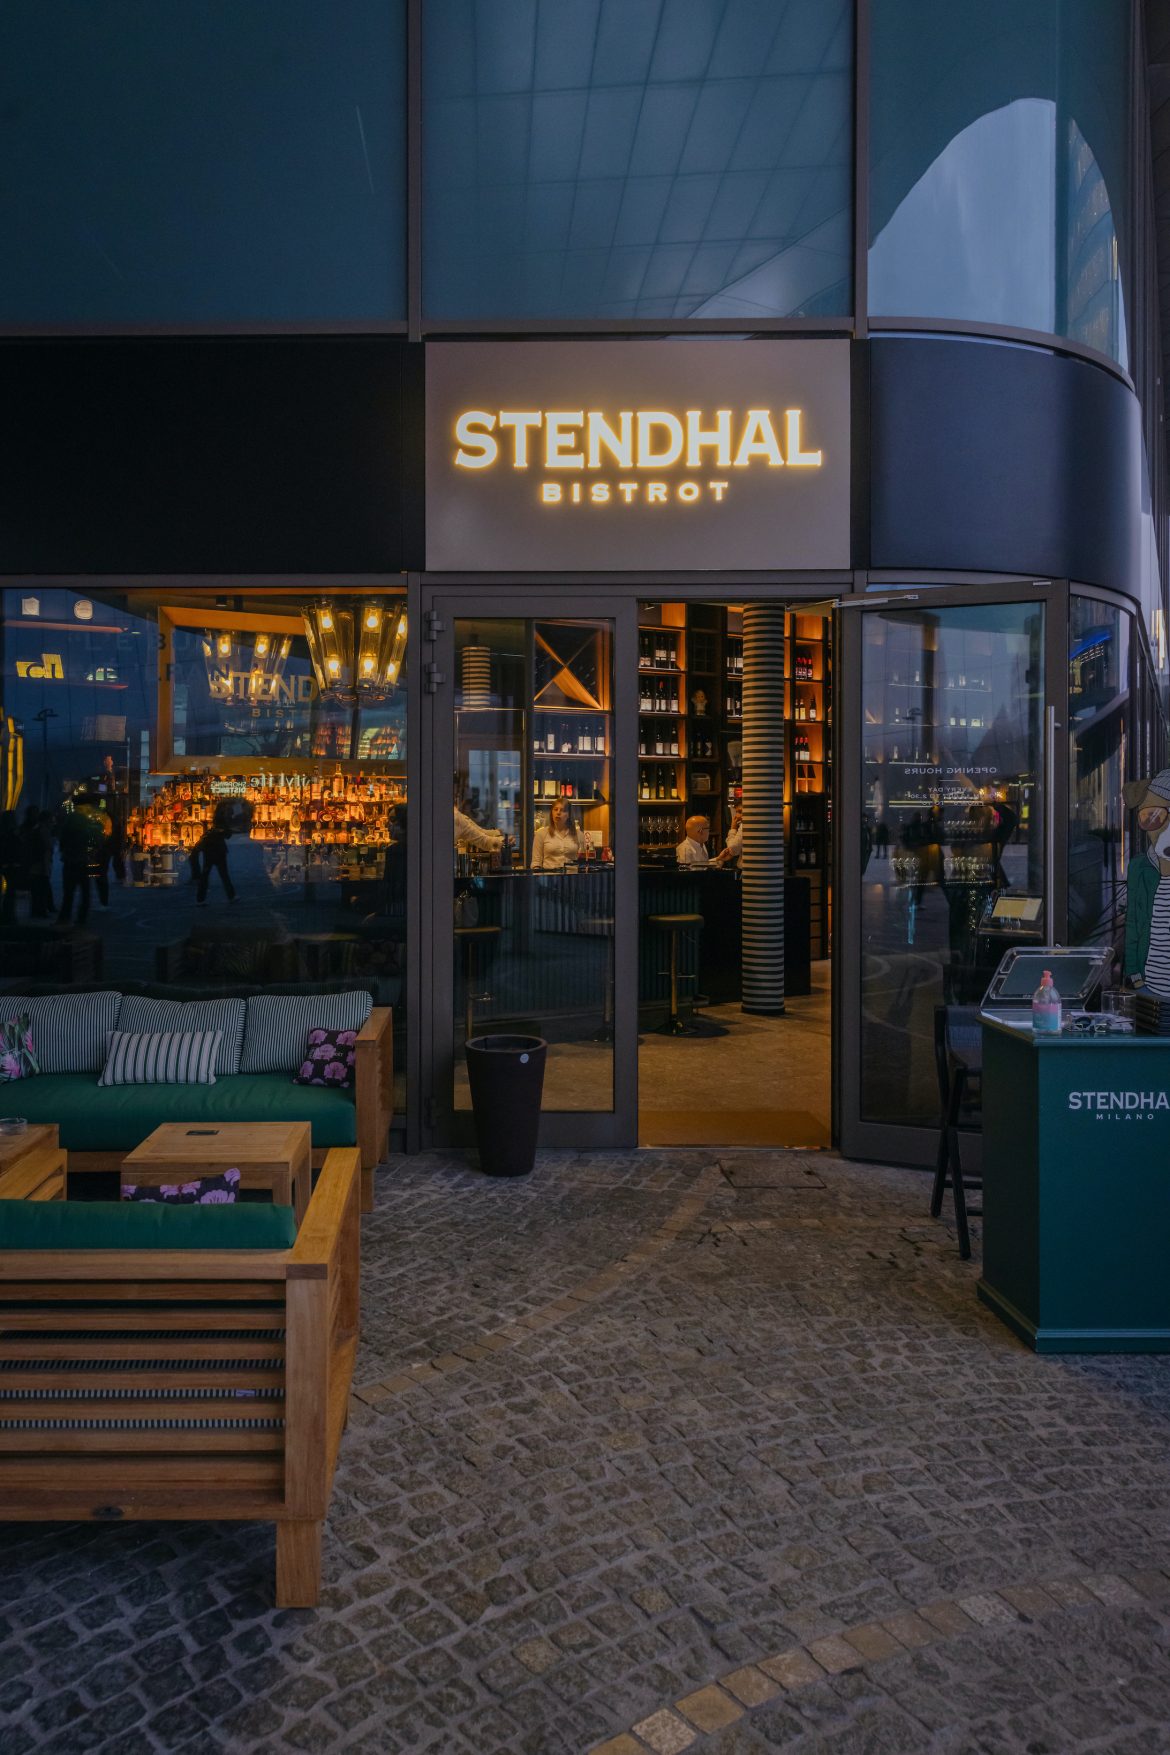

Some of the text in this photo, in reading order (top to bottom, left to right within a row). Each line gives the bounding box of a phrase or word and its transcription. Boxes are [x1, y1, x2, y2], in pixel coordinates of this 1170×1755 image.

[454, 409, 823, 469] STENDHAL
[541, 481, 730, 504] BISTROT
[209, 671, 319, 702] STEND
[1069, 1092, 1170, 1109] STENDHA
